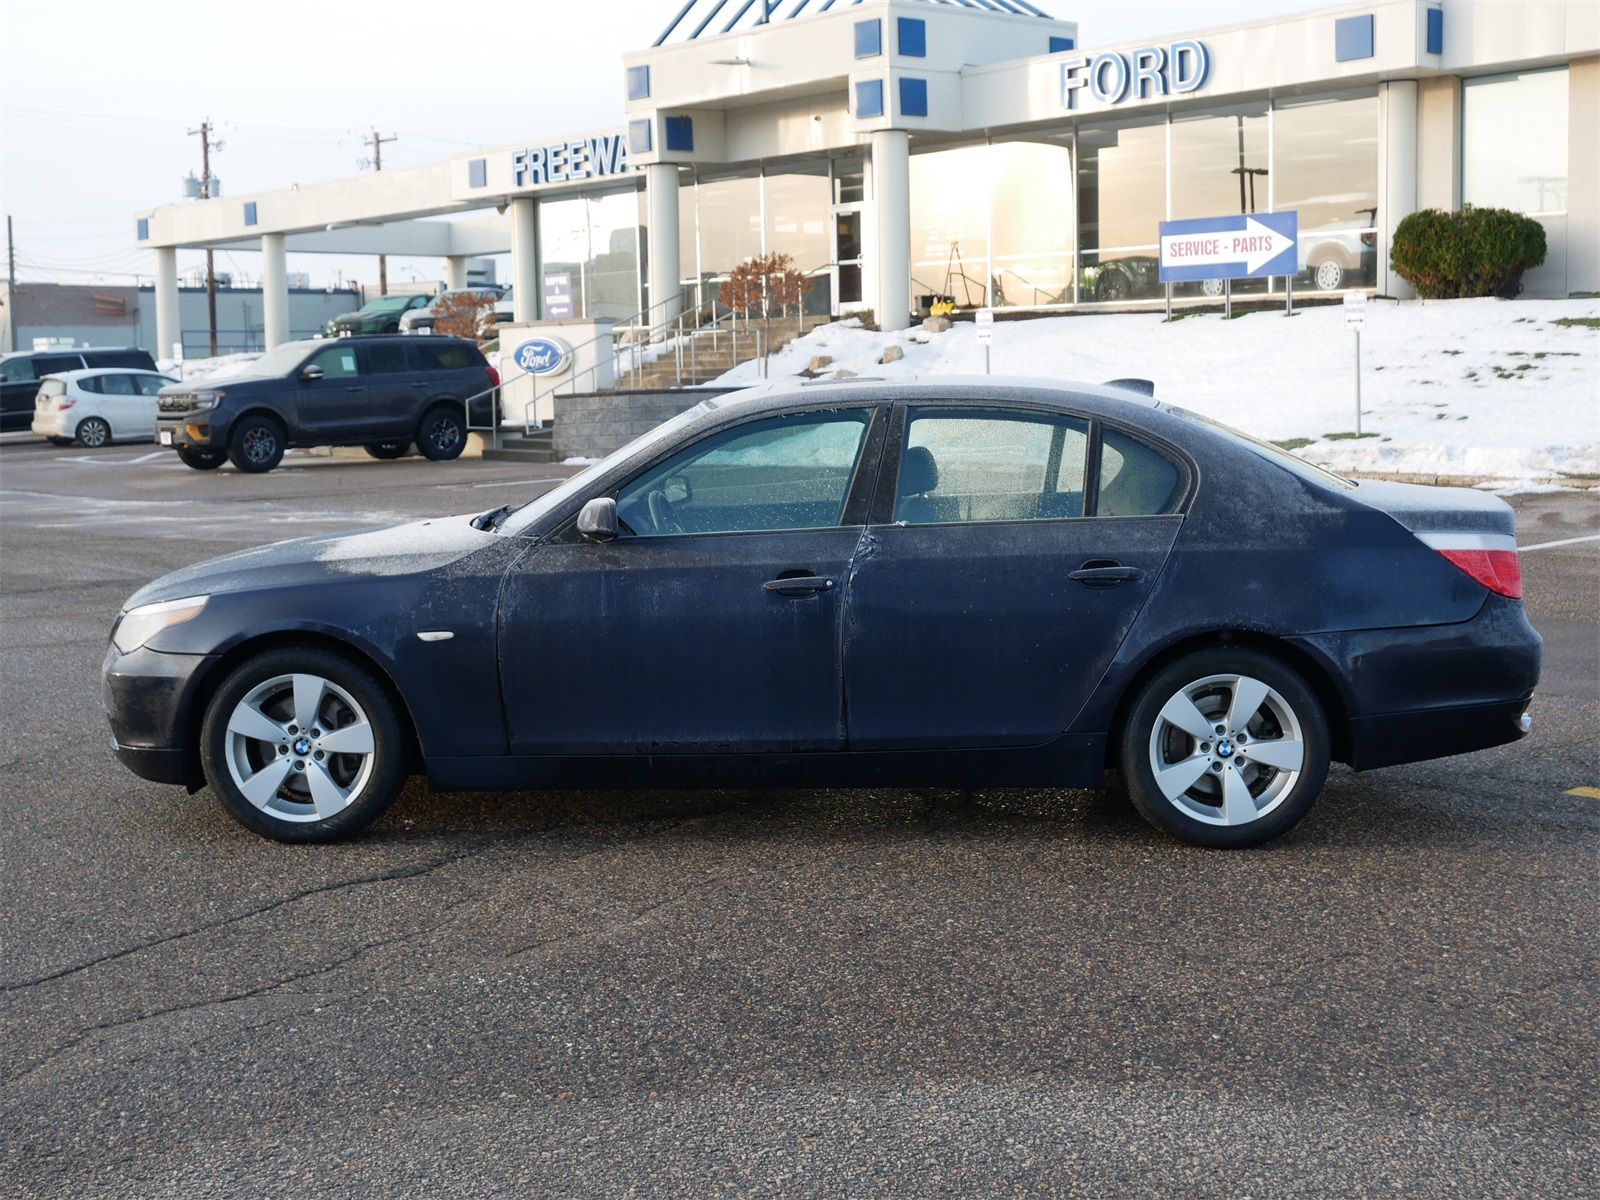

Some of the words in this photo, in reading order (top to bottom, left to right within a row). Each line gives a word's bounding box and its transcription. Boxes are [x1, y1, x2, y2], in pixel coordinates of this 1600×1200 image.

[1060, 39, 1210, 110] FORD
[1170, 239, 1220, 258] SERVICE
[1232, 235, 1273, 254] PARTS
[520, 345, 552, 368] Ford
